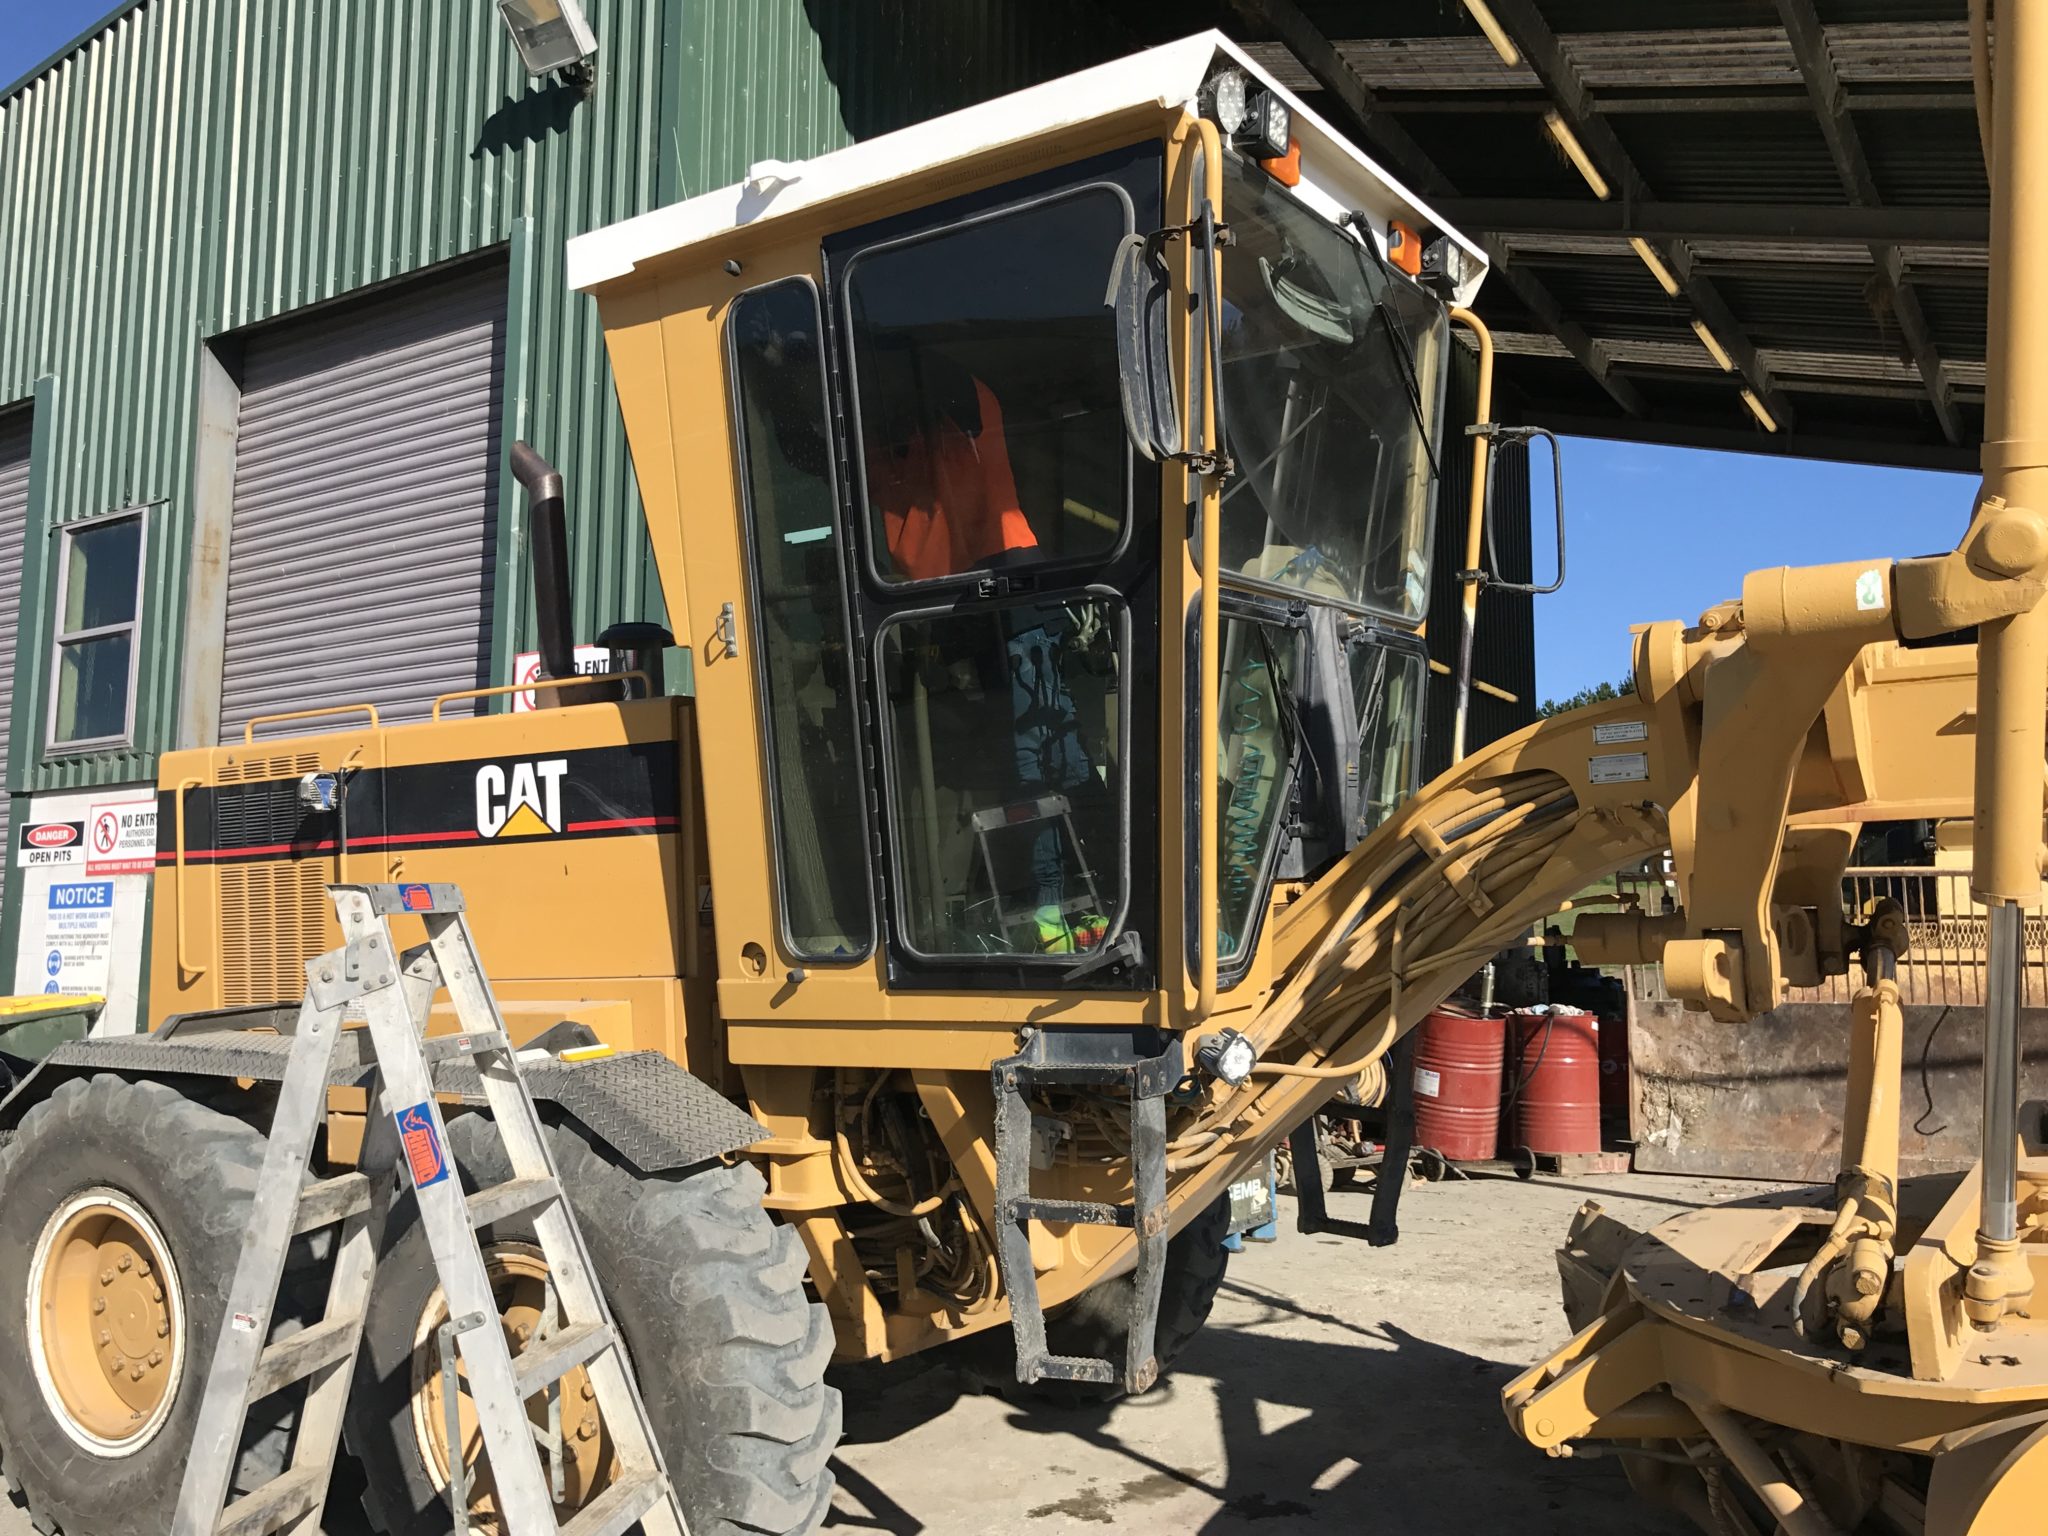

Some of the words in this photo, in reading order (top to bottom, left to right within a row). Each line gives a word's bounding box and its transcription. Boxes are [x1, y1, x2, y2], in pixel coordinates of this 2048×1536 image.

[585, 659, 608, 675] ENT
[476, 759, 568, 838] CAT
[121, 814, 133, 828] NO
[135, 812, 158, 827] ENTR
[36, 830, 69, 842] DANGER
[126, 828, 155, 838] AUTHORISED
[29, 851, 52, 863] OPEN
[54, 850, 72, 862] PITS
[55, 886, 106, 906] NOTICE
[405, 1129, 437, 1185] RHINO
